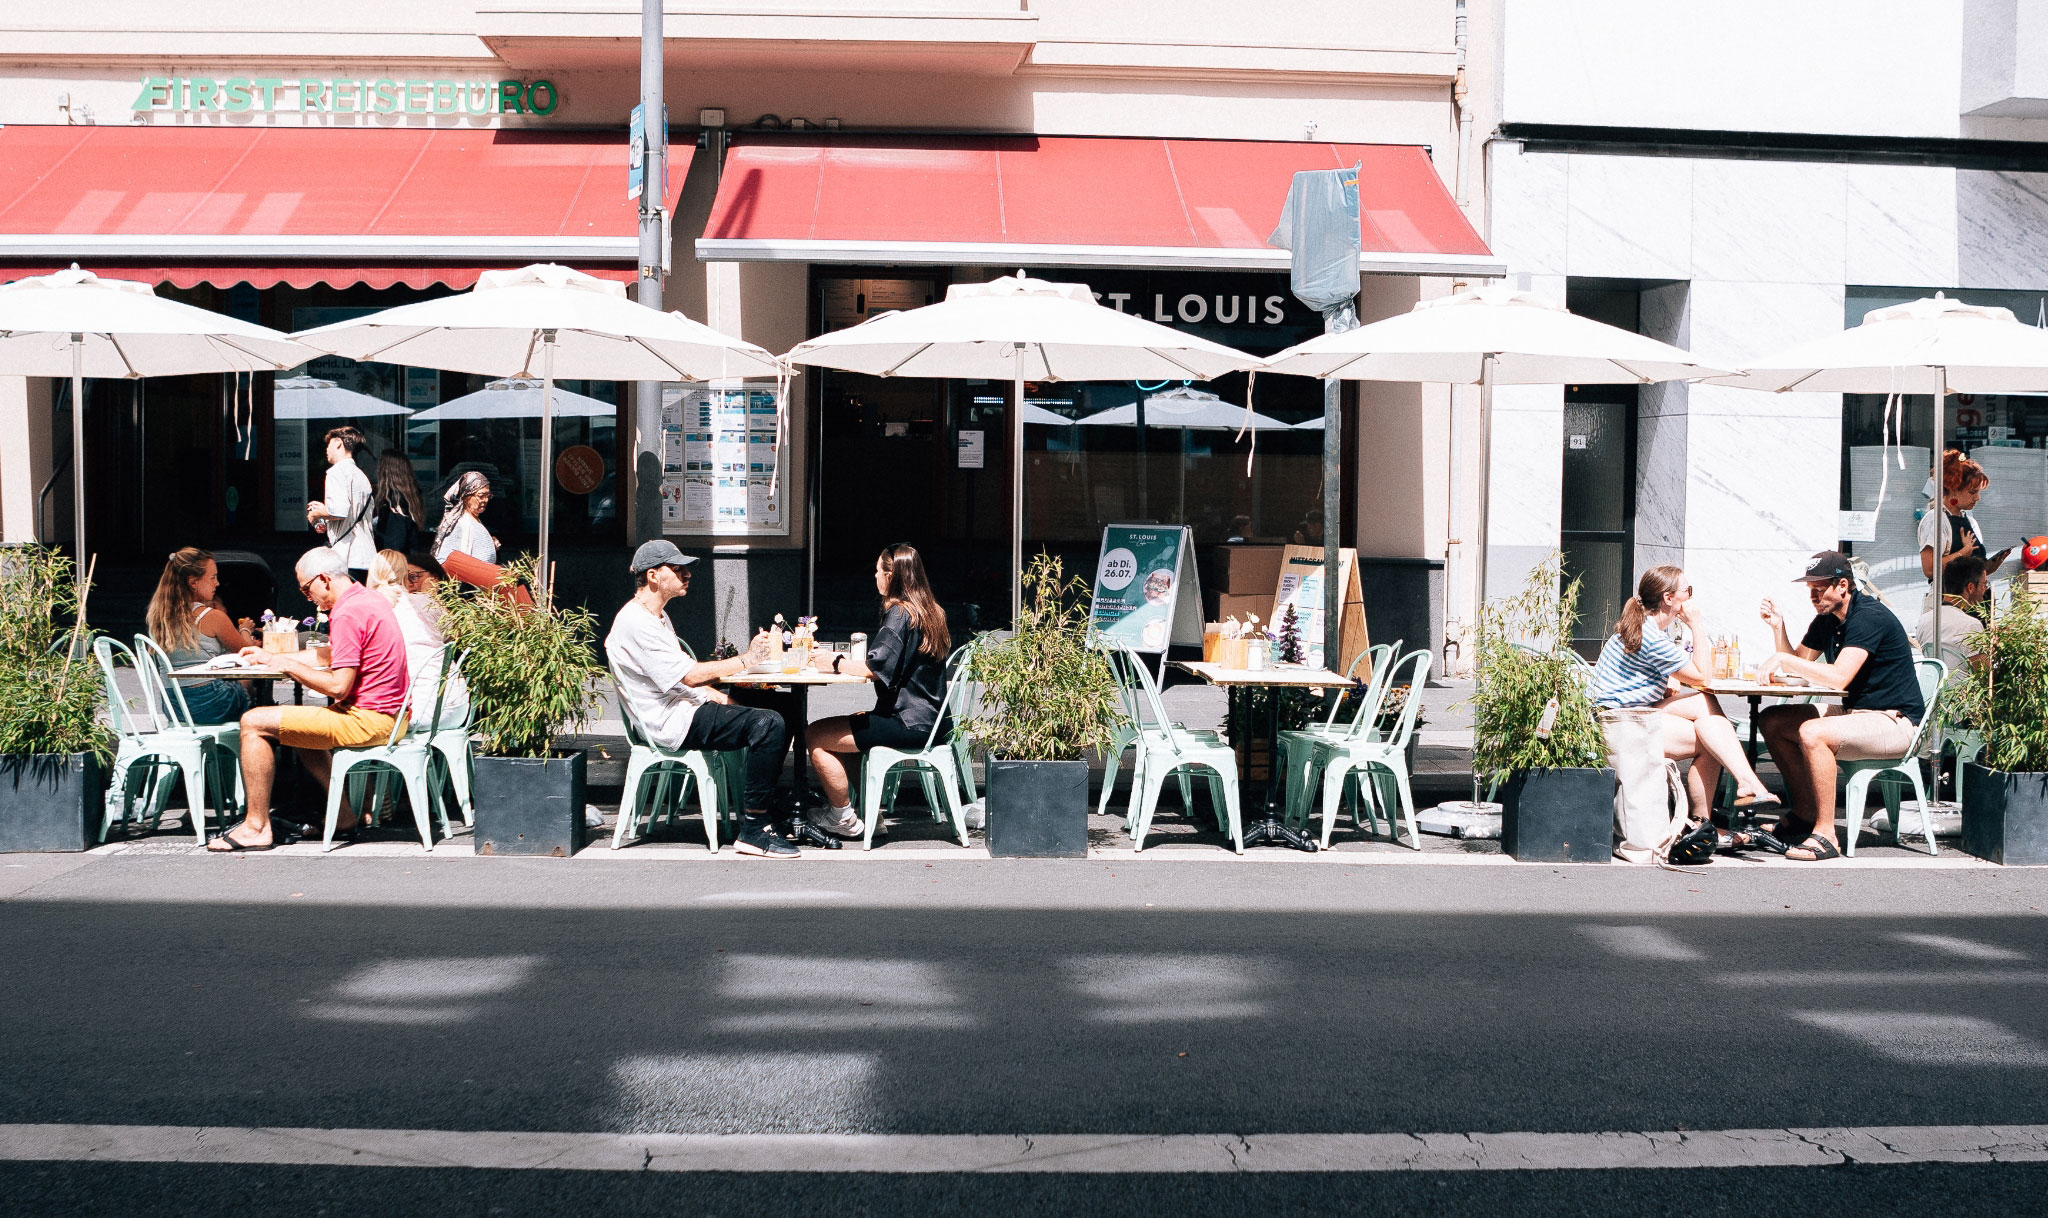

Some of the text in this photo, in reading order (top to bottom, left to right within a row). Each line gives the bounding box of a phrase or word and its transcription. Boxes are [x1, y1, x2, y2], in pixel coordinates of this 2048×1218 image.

[131, 77, 558, 116] FIRST REISEBÜRO
[1092, 292, 1285, 325] T. LOUIS
[1104, 569, 1131, 578] 26.07.
[1107, 560, 1131, 568] ab Di.
